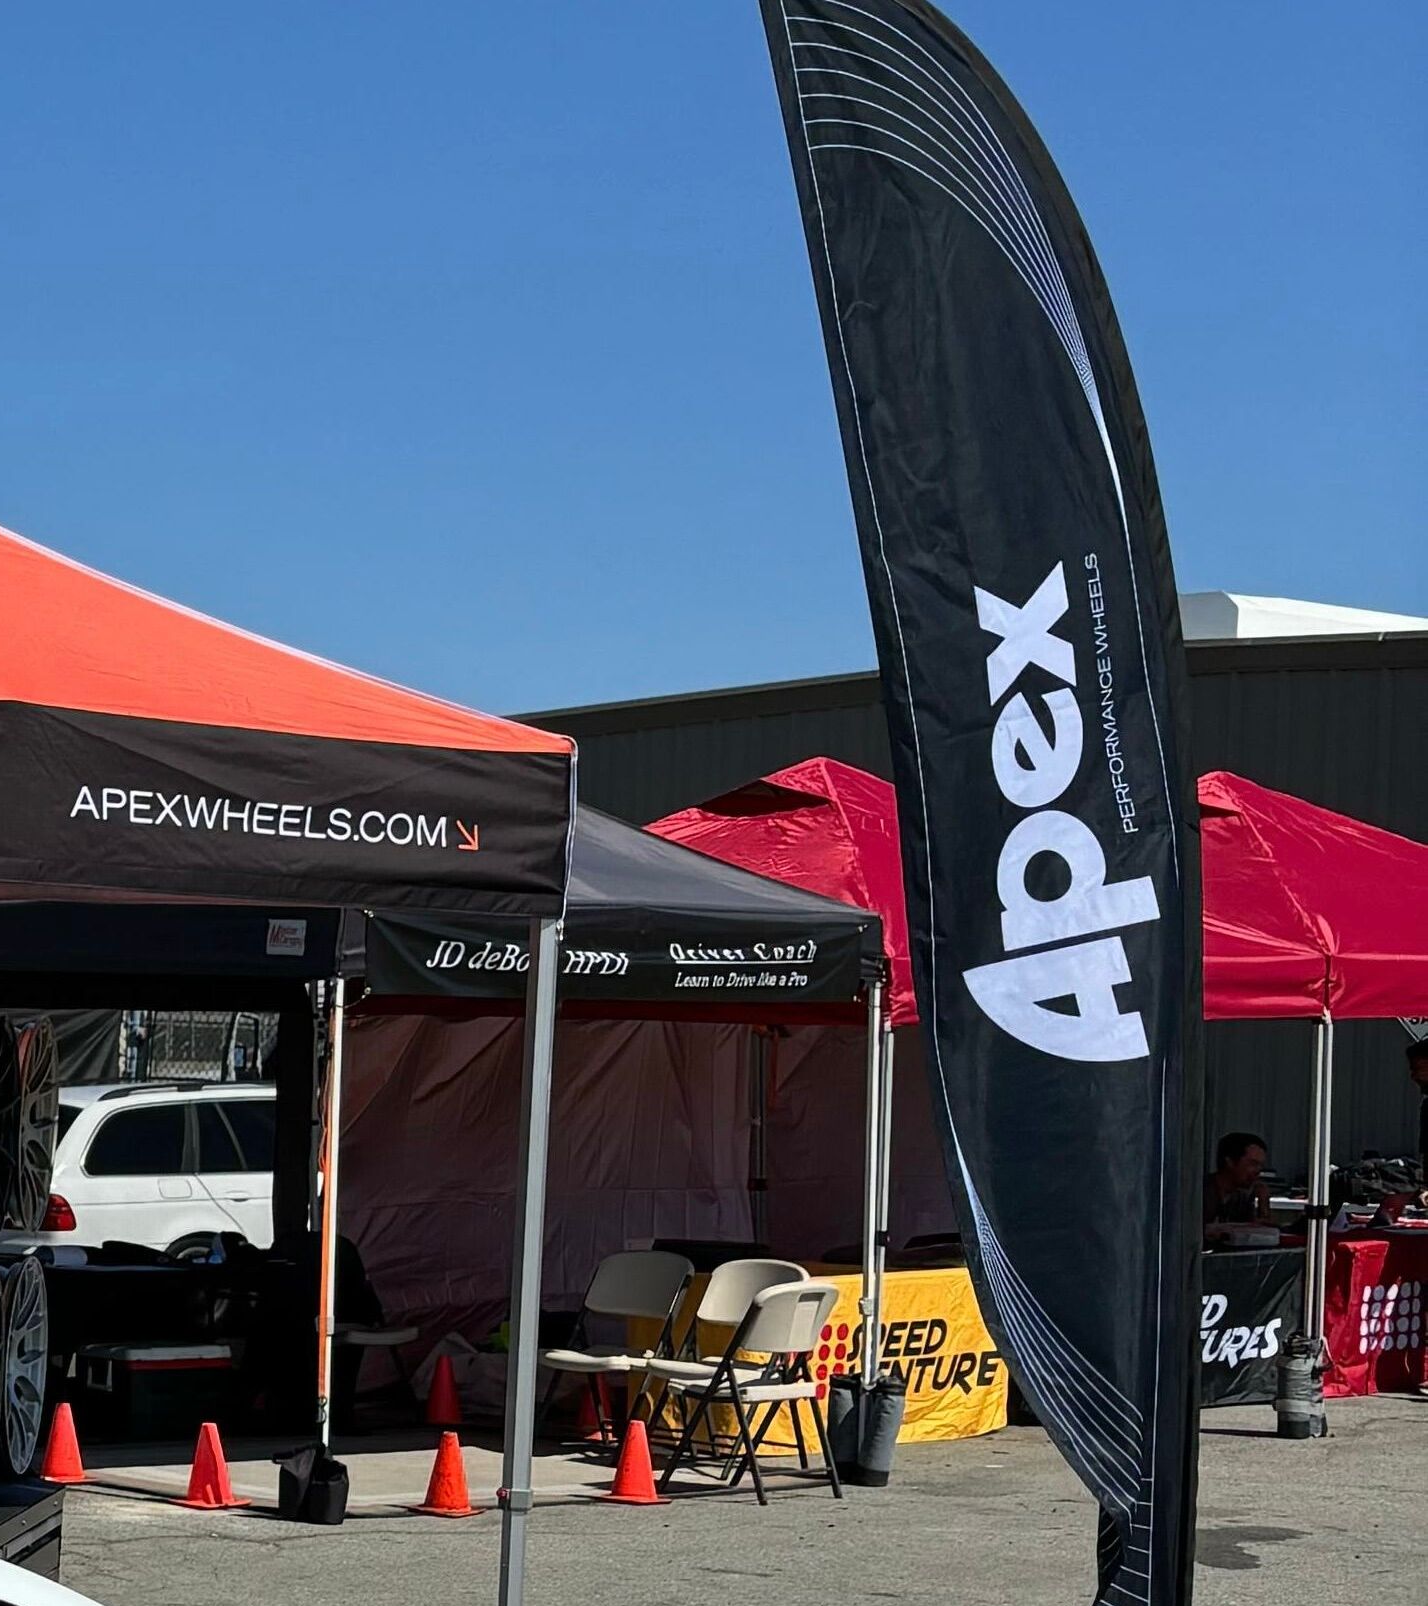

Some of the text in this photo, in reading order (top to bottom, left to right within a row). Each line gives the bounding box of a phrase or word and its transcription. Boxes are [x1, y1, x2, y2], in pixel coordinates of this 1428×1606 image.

[1083, 552, 1140, 834] PERFORMANCE WHEELS
[69, 785, 448, 849] APEXWHEELS.COM
[962, 560, 1161, 1062] Apex
[425, 940, 466, 968] JD
[467, 941, 530, 972] deBo
[669, 939, 818, 960] Driver Coach
[674, 971, 709, 988] Learn
[712, 973, 724, 988] to
[778, 974, 786, 987] a
[787, 970, 808, 987] Pro
[846, 1318, 948, 1362] SEED
